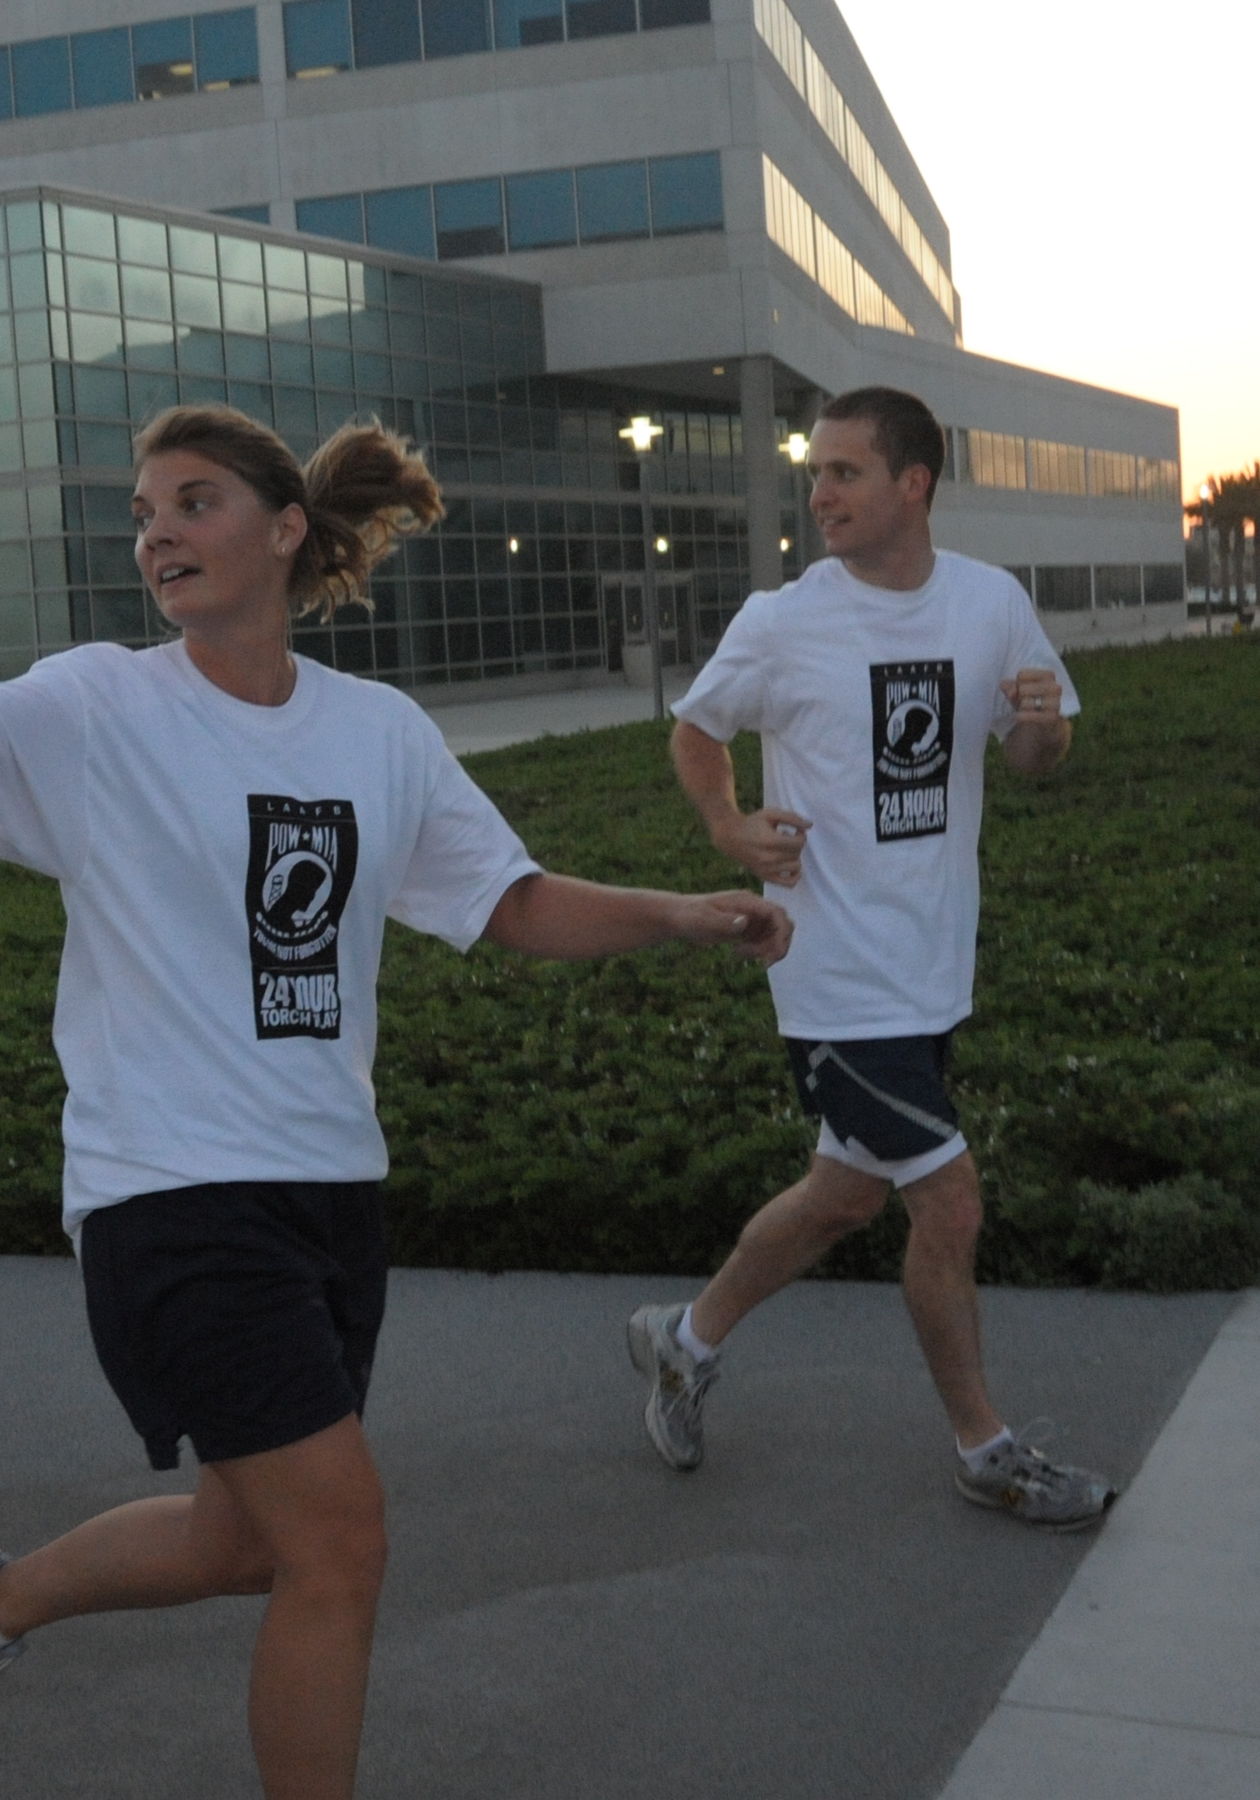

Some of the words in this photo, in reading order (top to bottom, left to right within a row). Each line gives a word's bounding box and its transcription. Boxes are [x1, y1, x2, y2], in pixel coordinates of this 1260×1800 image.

[886, 681, 911, 719] POW
[919, 679, 940, 716] MIA
[267, 801, 342, 817] LAAFB
[879, 792, 901, 821] 24
[903, 786, 944, 819] HOUR
[880, 818, 914, 836] TORCH
[265, 822, 302, 872] POW
[311, 826, 338, 875] MIA
[260, 972, 291, 1010] 24
[260, 1009, 311, 1027] TORCH
